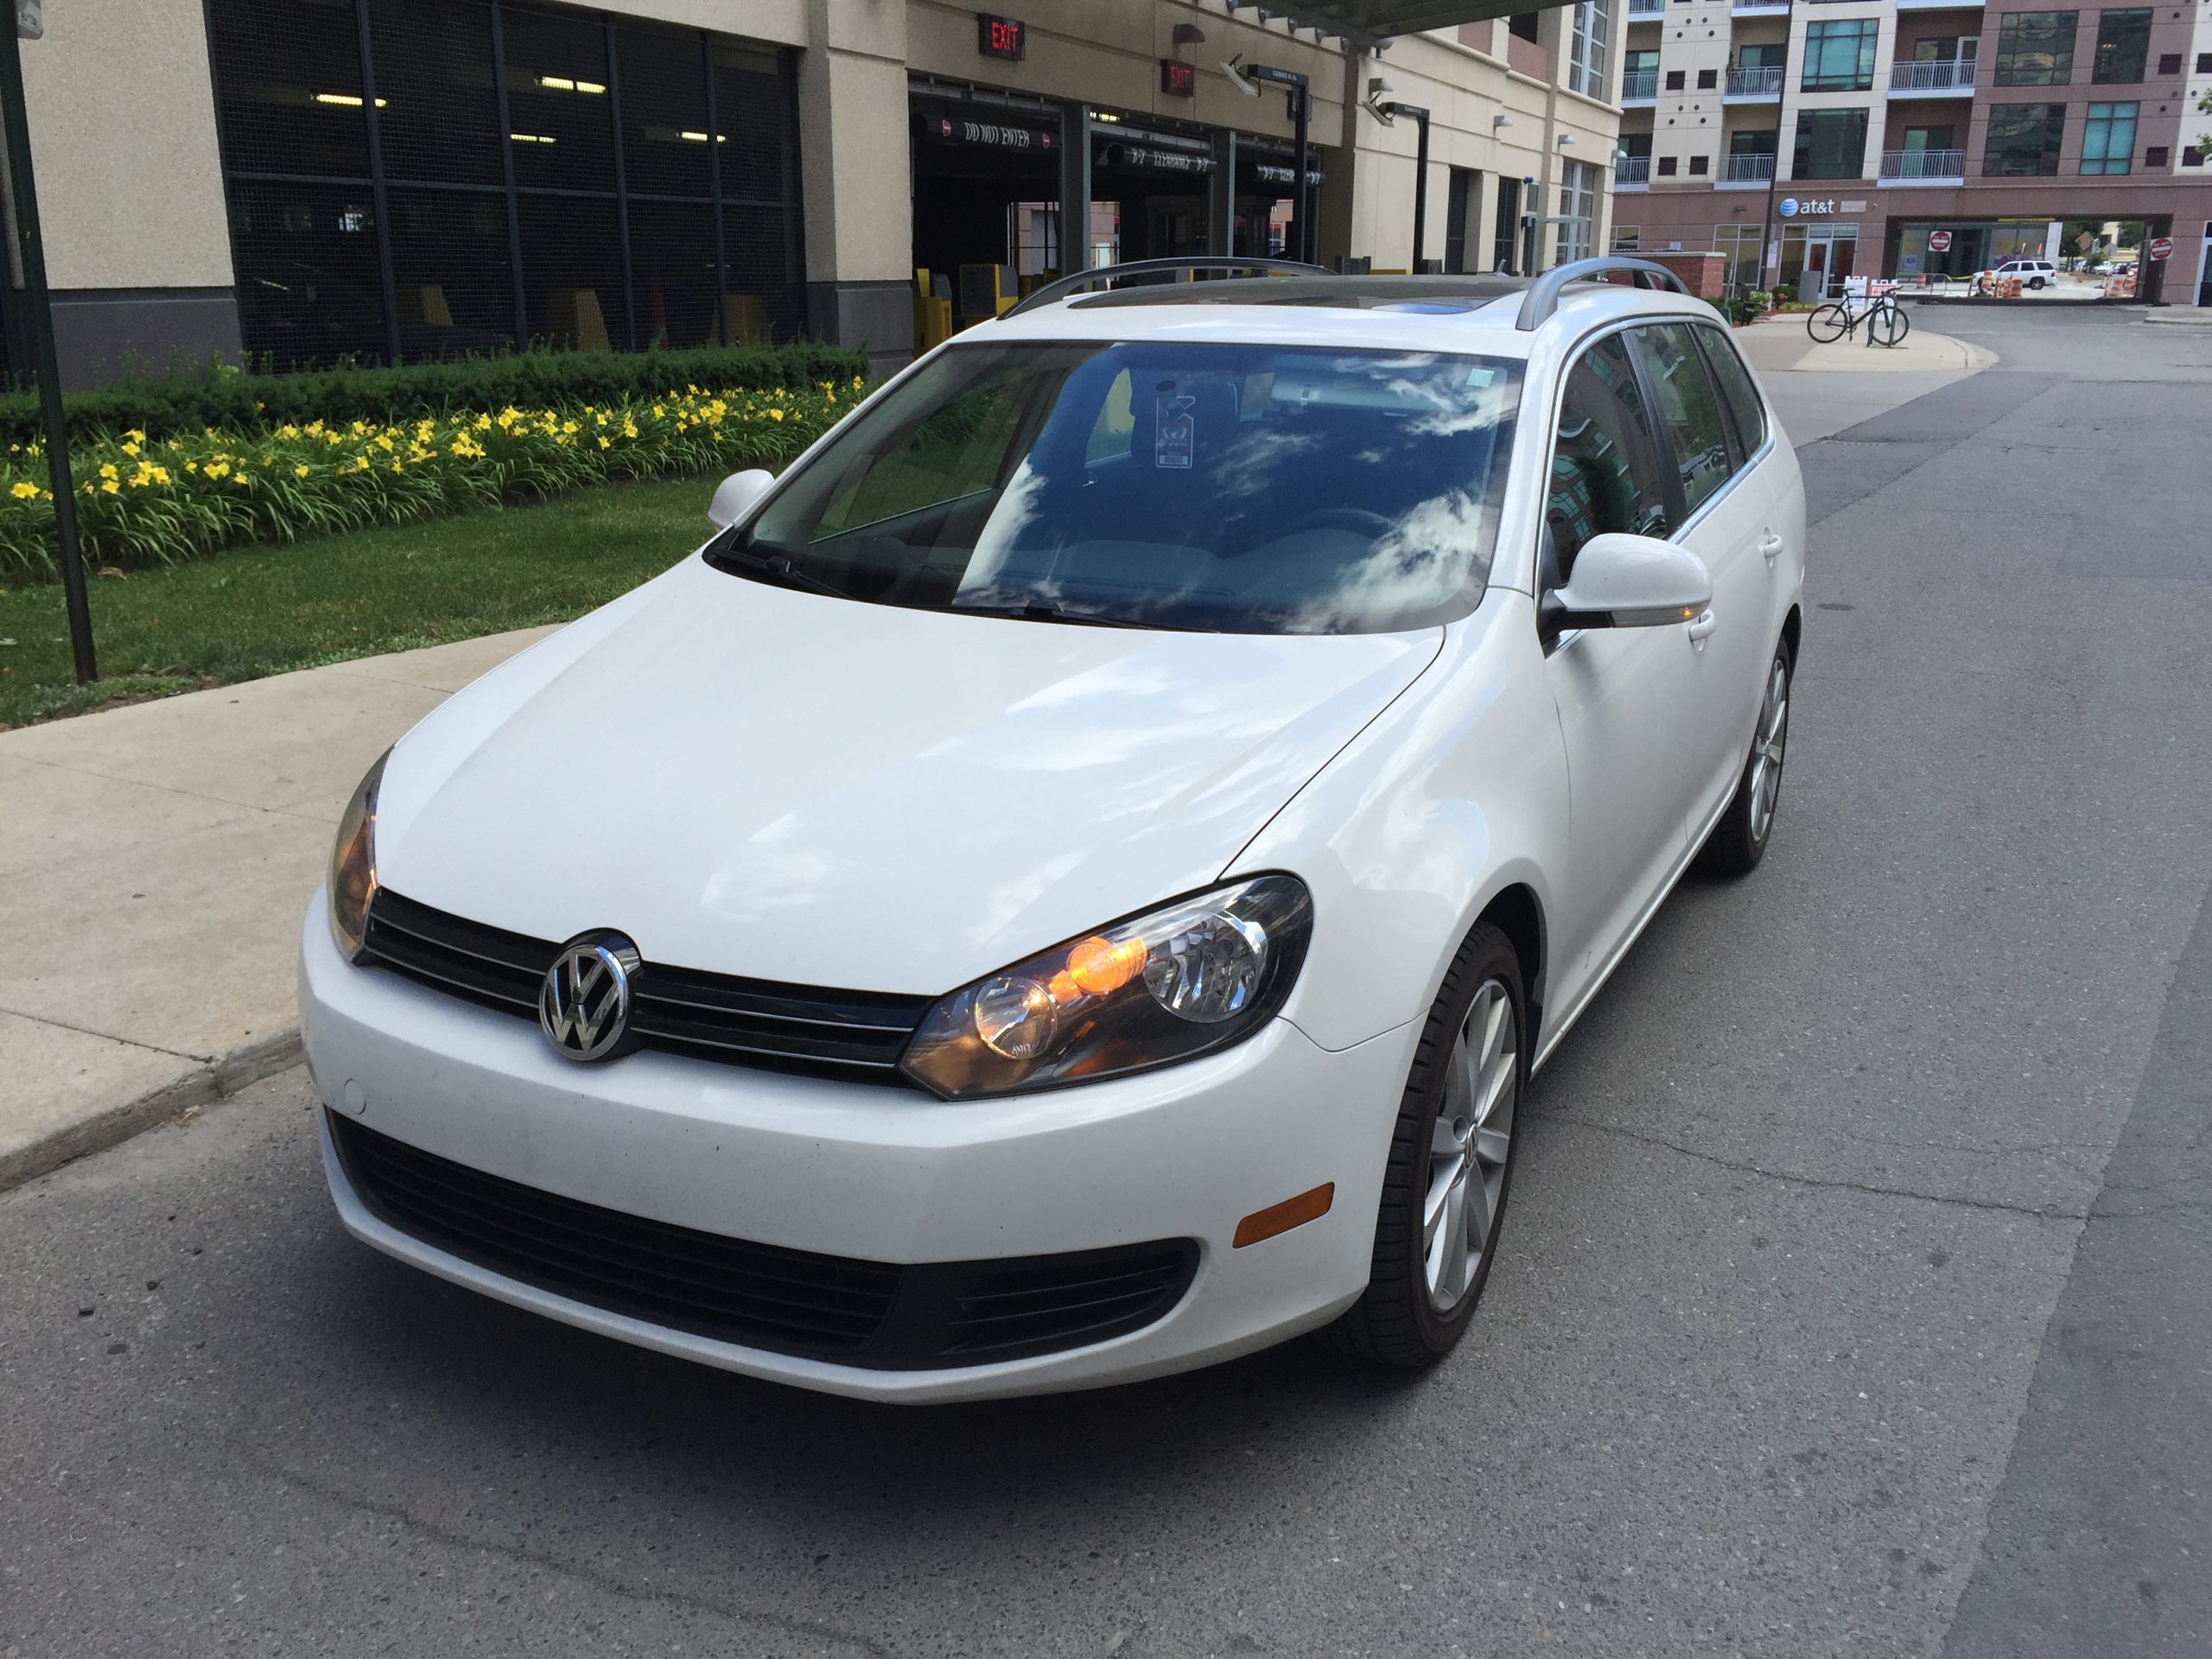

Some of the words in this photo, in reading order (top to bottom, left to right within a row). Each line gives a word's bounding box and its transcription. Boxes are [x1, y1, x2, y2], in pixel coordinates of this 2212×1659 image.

[992, 22, 1019, 53] EXIT
[1170, 65, 1190, 88] EXIT
[964, 122, 980, 142] DO
[981, 124, 999, 144] NOT
[1001, 127, 1030, 148] ENTER
[1154, 150, 1190, 170] CLEARANCE
[1800, 199, 1835, 214] at&t
